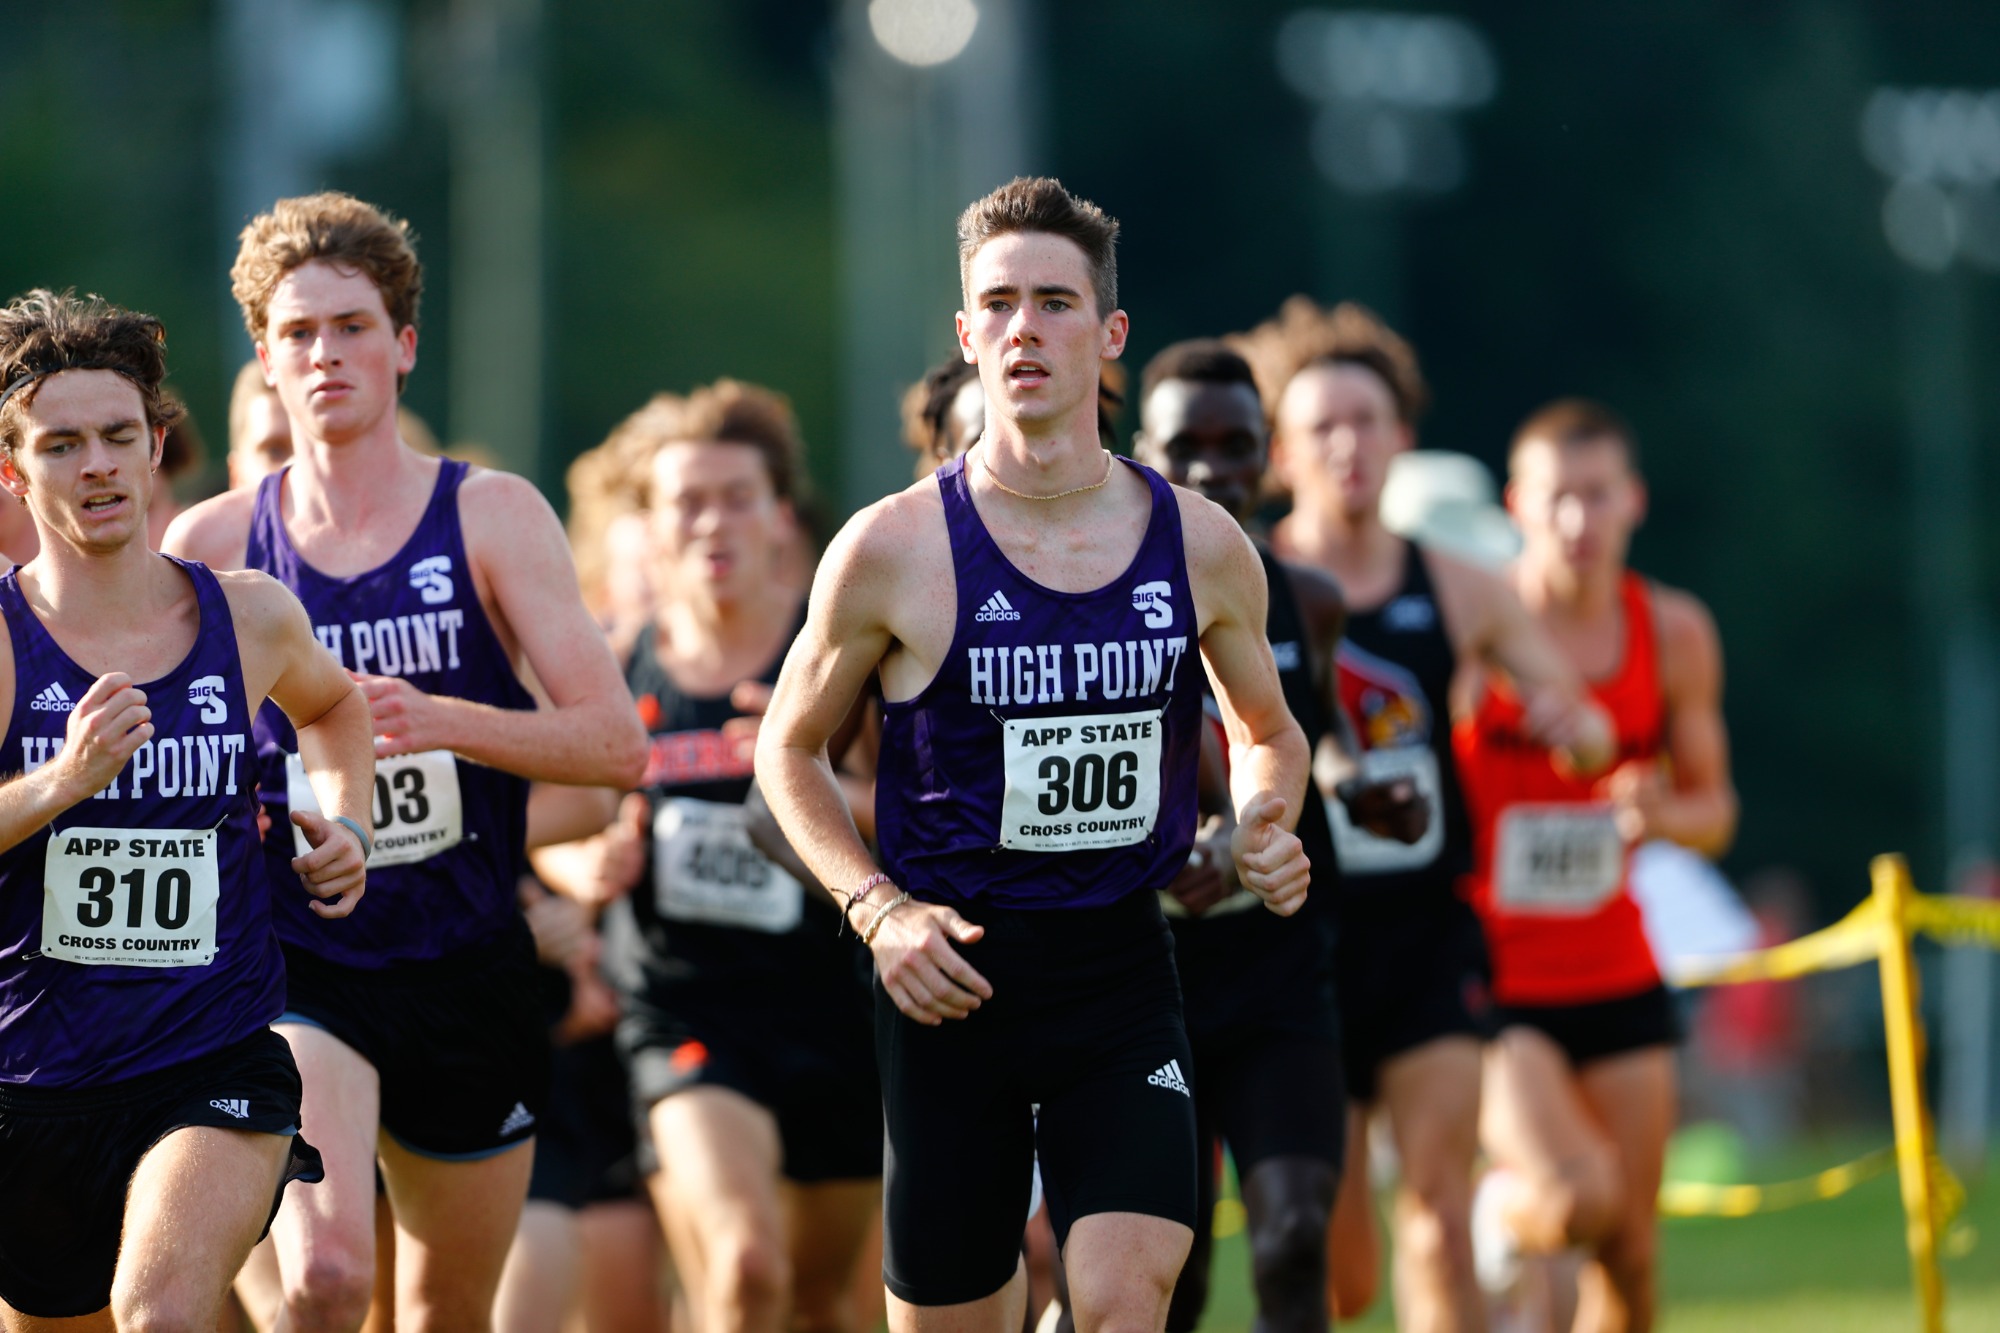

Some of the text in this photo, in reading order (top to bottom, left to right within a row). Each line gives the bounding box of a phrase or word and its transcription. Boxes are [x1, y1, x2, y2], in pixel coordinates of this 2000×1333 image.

[975, 609, 1021, 622] adidas
[1132, 592, 1154, 604] BIG
[1144, 580, 1173, 629] S
[351, 609, 463, 676] POINT
[968, 636, 1188, 706] HIGH POINT
[188, 686, 210, 699] BIG
[200, 675, 228, 725] S
[1021, 720, 1153, 747] APP STATE
[131, 733, 245, 800] POINT
[1037, 750, 1139, 816] 306
[372, 766, 430, 831] 03
[374, 828, 447, 851] COUNTRY
[1019, 816, 1146, 837] CROSS COUNTRY
[64, 837, 205, 858] APP STATE
[76, 866, 191, 930] 310
[58, 934, 201, 952] CROSS COUNTRY
